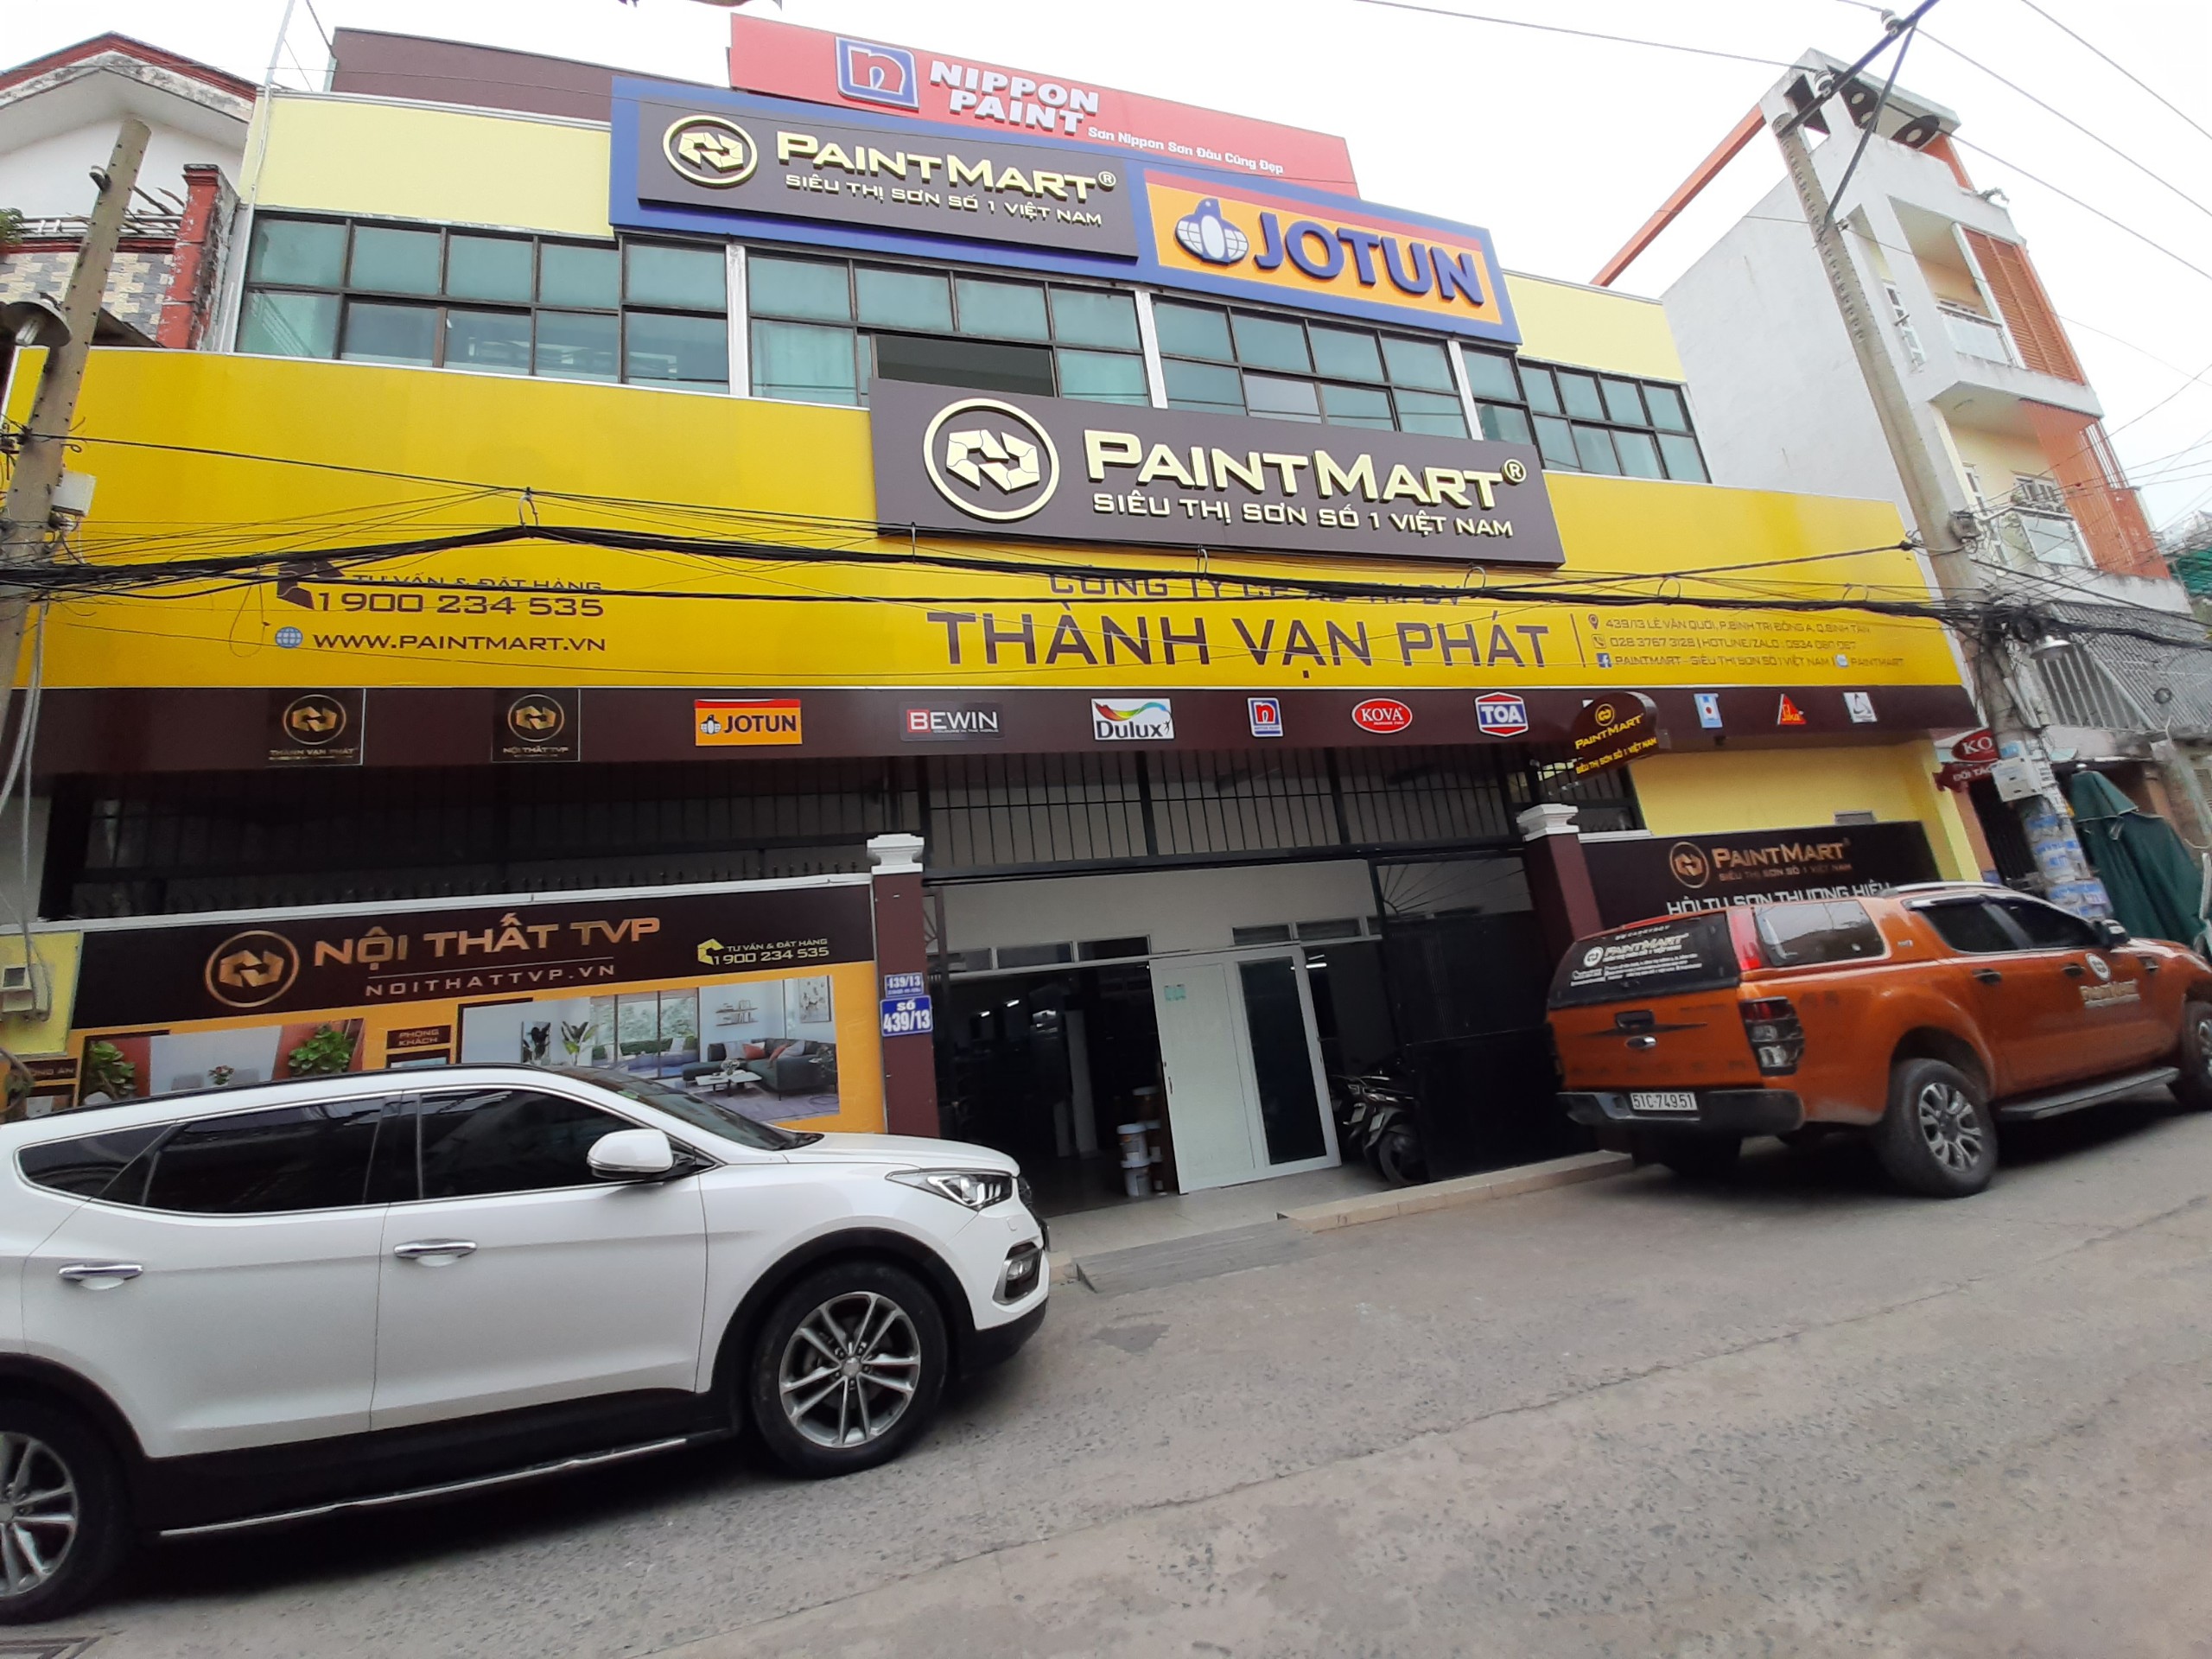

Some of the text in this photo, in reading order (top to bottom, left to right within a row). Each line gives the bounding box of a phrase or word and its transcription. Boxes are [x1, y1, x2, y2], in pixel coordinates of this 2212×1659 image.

[930, 60, 1098, 115] NIPPON
[950, 89, 1084, 135] PAINT
[1118, 130, 1164, 150] Nippon
[785, 175, 1102, 226] SIÊU THỊ SƠN SỐ 1 VIỆT NAM
[1254, 211, 1484, 305] JOTUN
[1093, 489, 1513, 538] SIÊU THỊ SƠN SỐ 1 VIỆT NAM
[437, 594, 516, 615] 234
[529, 597, 604, 617] 535
[313, 633, 605, 652] WWW.PAINTMART.VN
[926, 602, 1548, 677] THÀNH VẠN PHÁT
[1637, 638, 1666, 647] 3767
[724, 715, 797, 734] JOTUN
[910, 711, 998, 730] BEWIN
[1361, 708, 1404, 721] KOVA
[1480, 705, 1522, 724] TOA
[1096, 720, 1163, 739] Dulux
[1962, 736, 1993, 756] KO
[314, 912, 660, 970] NỘI THẤT TVP
[760, 950, 793, 962] 234
[797, 947, 830, 958] 535
[365, 965, 615, 996] NOITHATTVP.VN
[884, 1008, 931, 1033] 439/13
